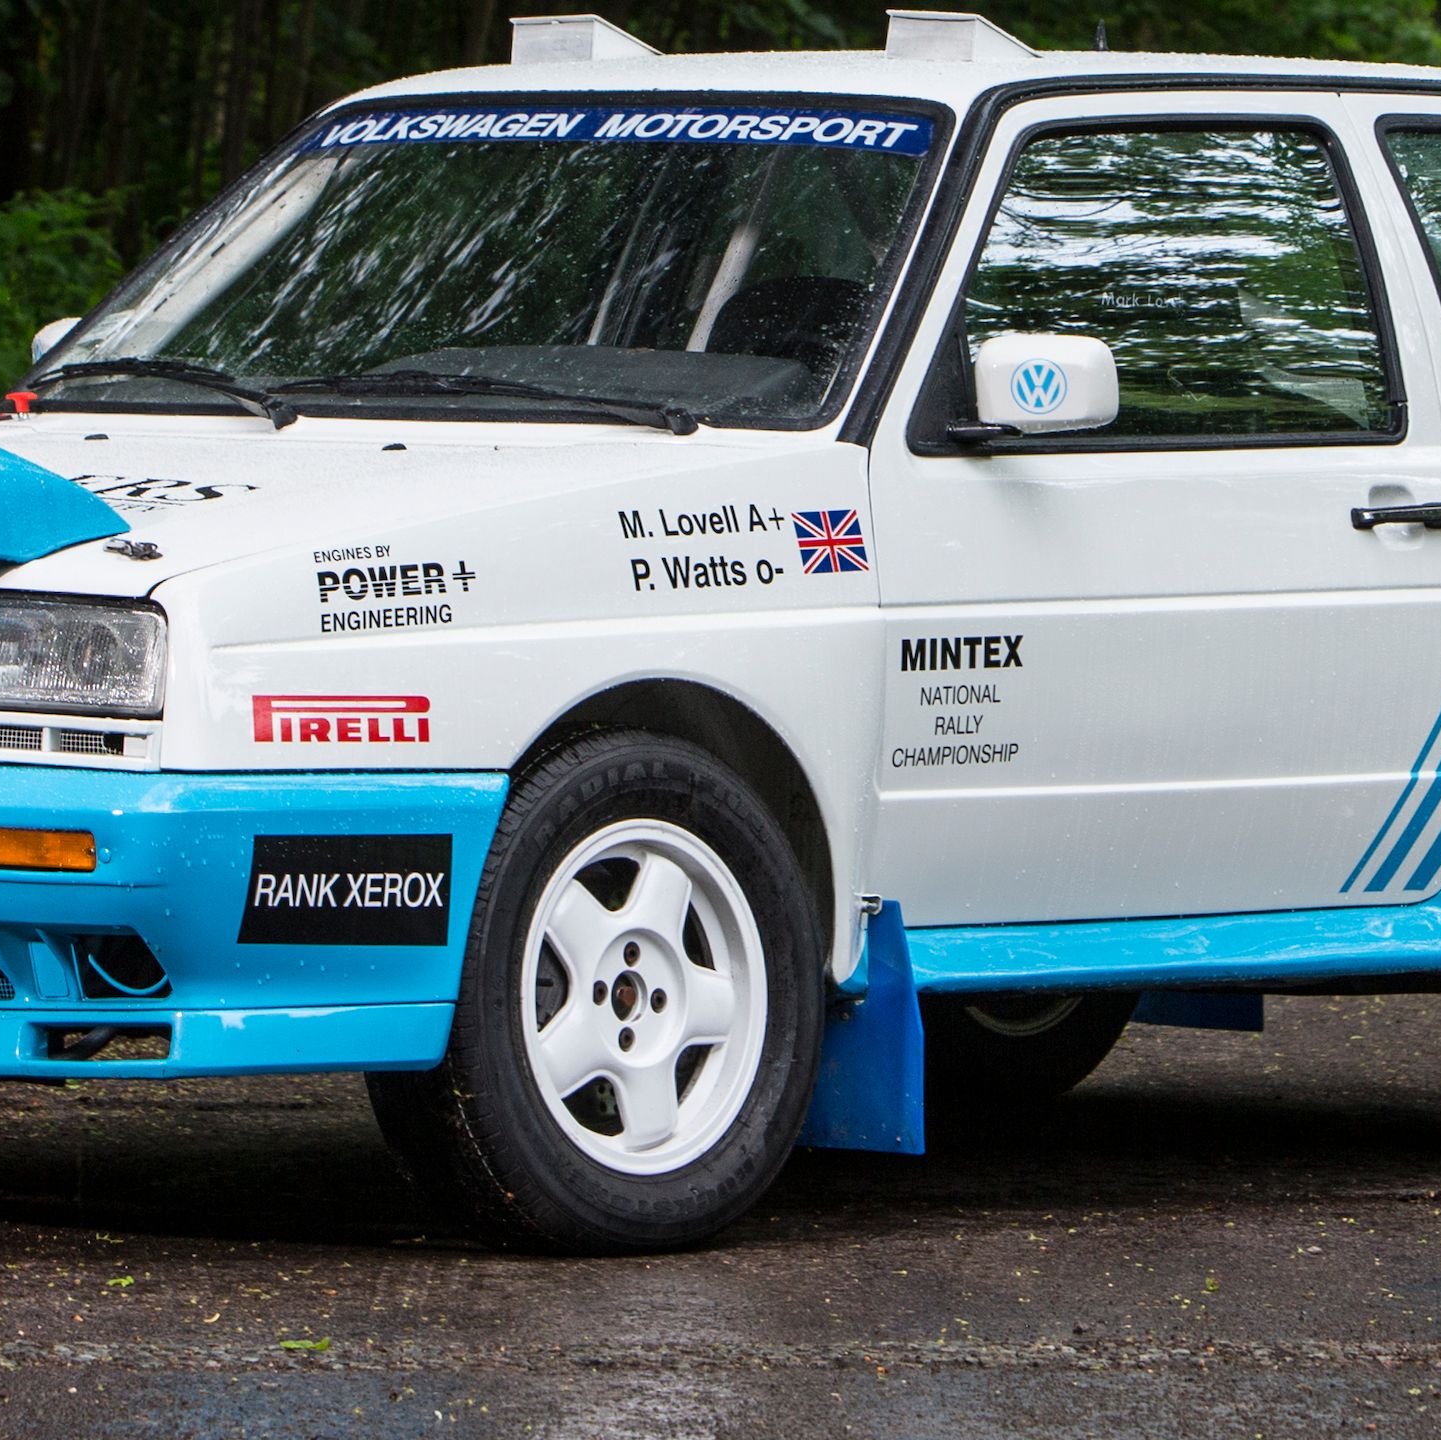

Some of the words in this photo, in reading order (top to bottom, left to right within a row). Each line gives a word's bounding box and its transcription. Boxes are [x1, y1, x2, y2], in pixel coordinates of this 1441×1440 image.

[321, 113, 585, 147] VOLKSWAGEN
[594, 113, 918, 148] MOTORSPORT
[1101, 291, 1140, 308] Mark
[1011, 359, 1067, 414] VW
[618, 511, 654, 539] M.
[659, 505, 740, 537] Lovell
[749, 504, 785, 533] A+
[314, 547, 372, 563] ENGINES
[375, 546, 391, 558] BY
[631, 559, 656, 591] P.
[662, 556, 747, 589] Watts
[321, 604, 453, 633] ENGINEERING
[901, 635, 1024, 672] MINTEX
[919, 684, 1001, 706] NATIONAL
[252, 695, 430, 742] PIRELLI
[934, 715, 984, 736] RALLY
[891, 743, 1019, 768] CHAMPIONSHIP
[254, 873, 341, 907] RANK
[343, 872, 444, 907] XEROX
